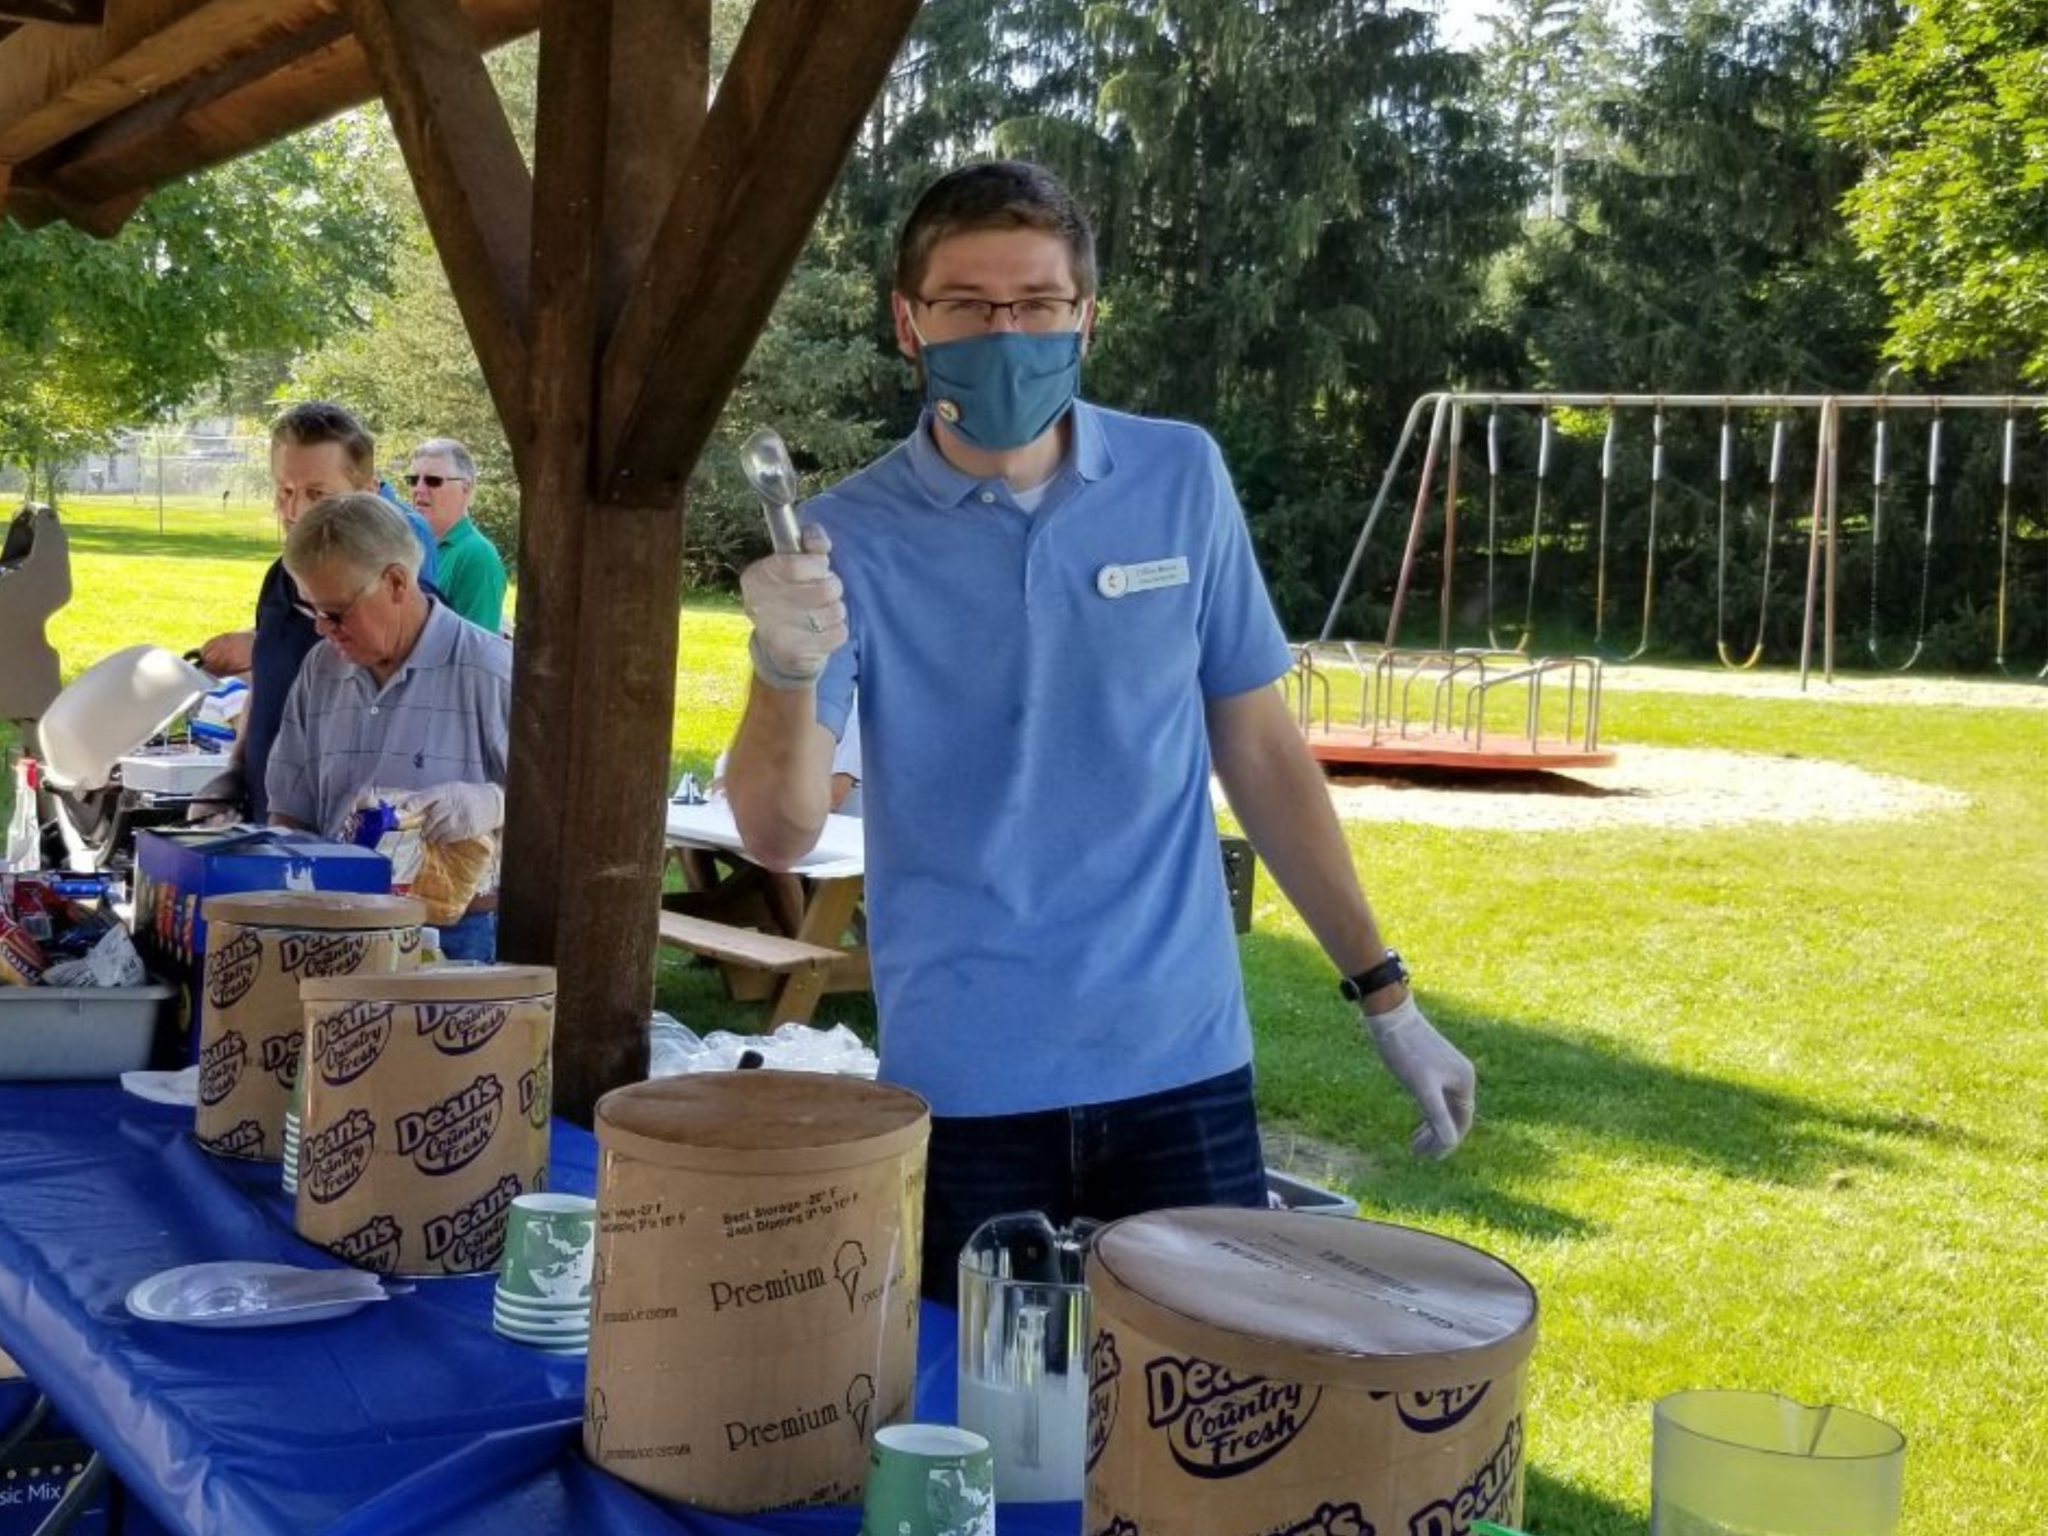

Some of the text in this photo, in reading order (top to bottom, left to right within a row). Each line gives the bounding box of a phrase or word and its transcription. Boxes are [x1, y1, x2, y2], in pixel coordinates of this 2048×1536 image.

[395, 1073, 503, 1156] Dean's
[425, 1110, 493, 1161] Country
[444, 1126, 490, 1166] Fresh
[710, 1265, 827, 1312] Premium
[724, 1402, 840, 1451] Premium
[1183, 1382, 1302, 1449] Country
[1206, 1407, 1296, 1466] Fresh
[28, 1482, 61, 1503] Mix
